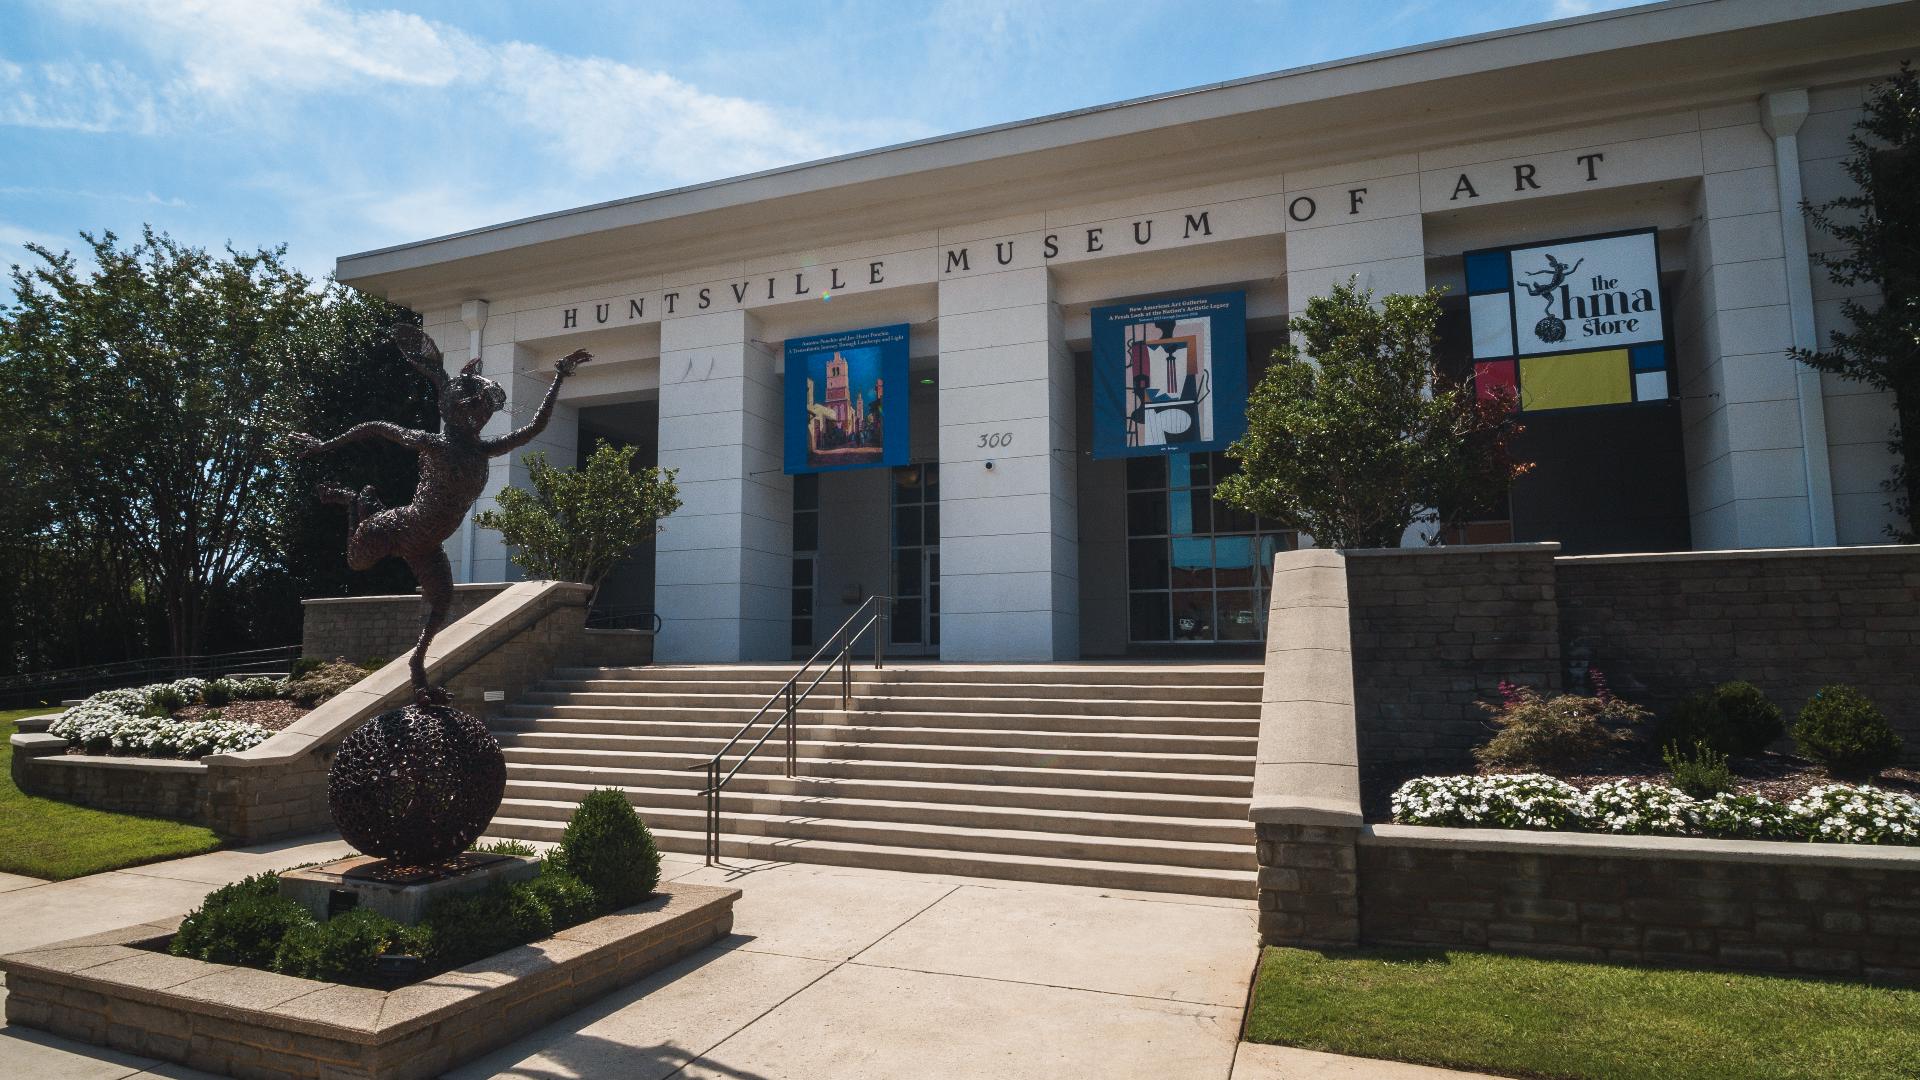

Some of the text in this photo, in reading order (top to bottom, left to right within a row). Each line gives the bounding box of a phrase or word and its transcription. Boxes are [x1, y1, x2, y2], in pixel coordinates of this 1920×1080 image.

[563, 153, 1604, 329] HUNTSVILLE MUSEUM OF ART
[1591, 275, 1619, 291] the
[1143, 303, 1171, 311] American
[1162, 307, 1186, 315] Nation's
[1186, 304, 1209, 312] Artistic
[1559, 284, 1656, 320] hma
[1582, 318, 1640, 337] store
[977, 432, 1013, 448] 300
